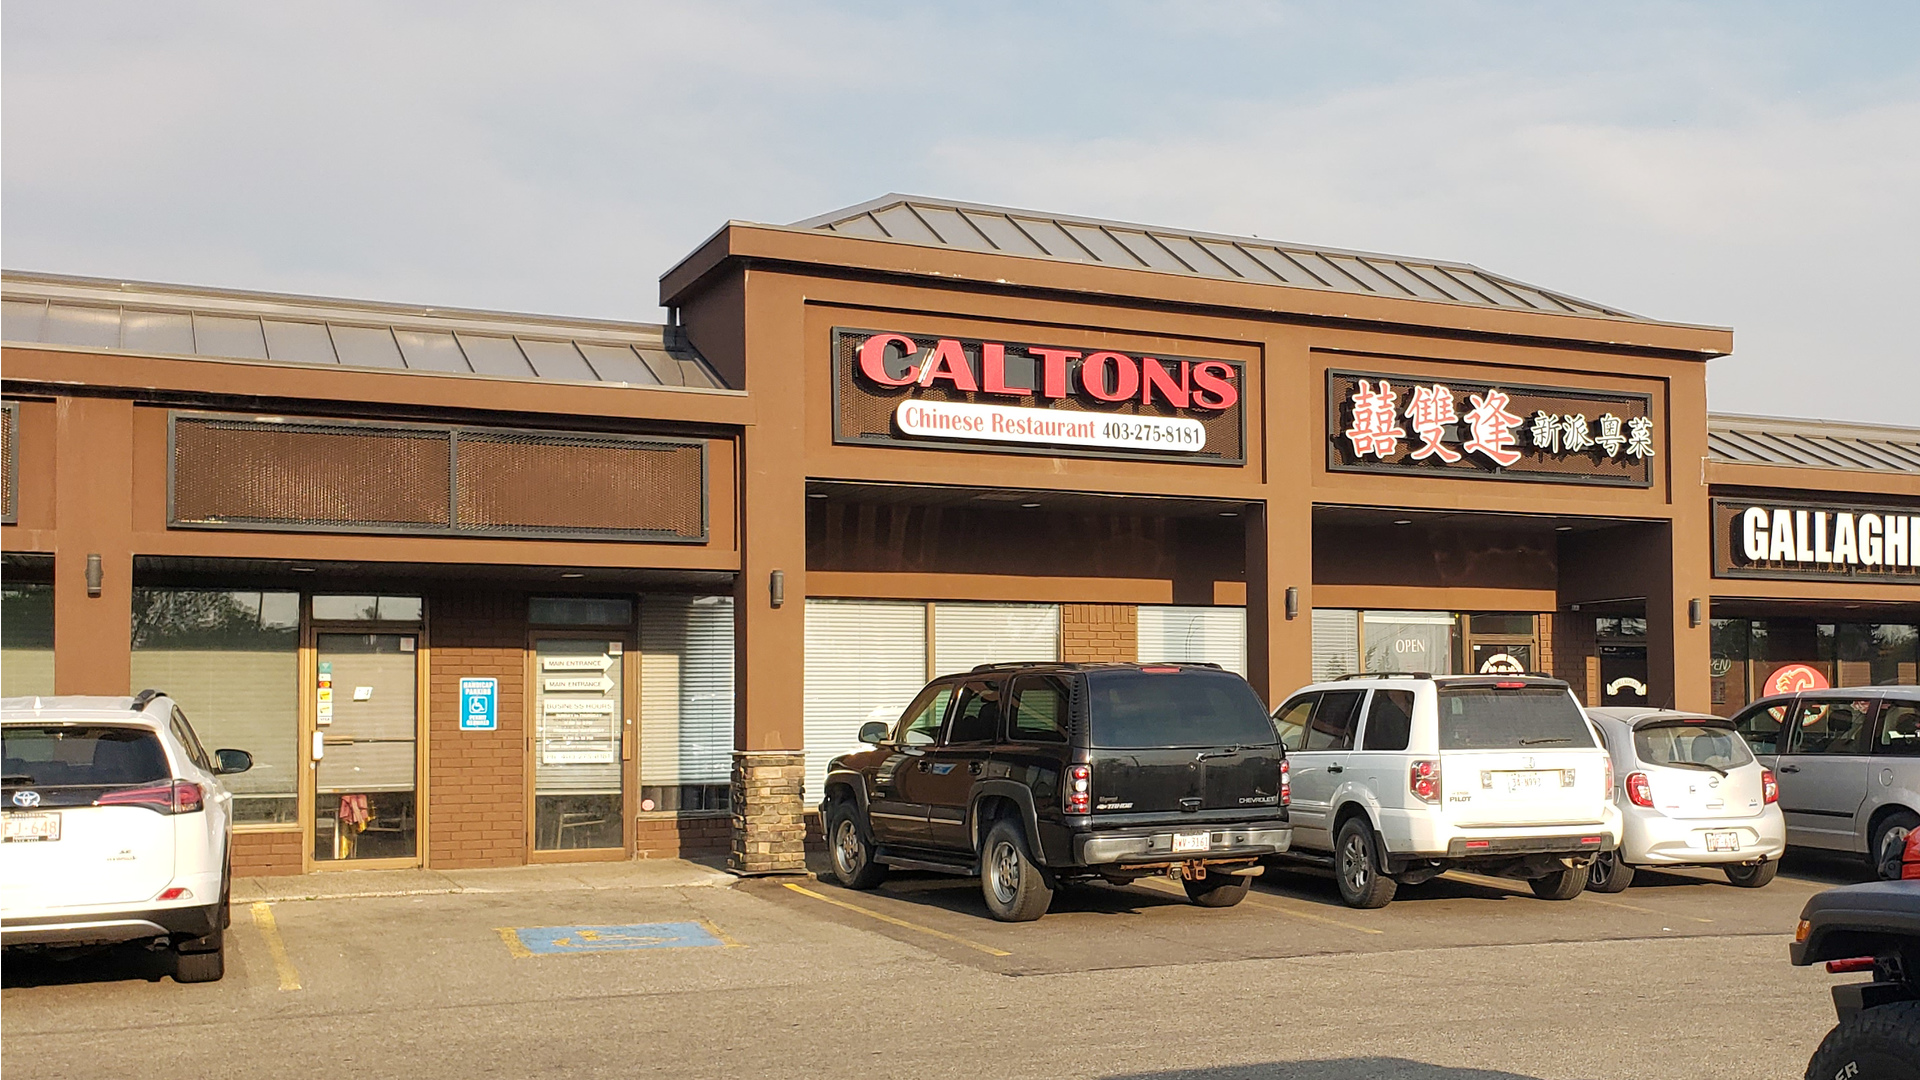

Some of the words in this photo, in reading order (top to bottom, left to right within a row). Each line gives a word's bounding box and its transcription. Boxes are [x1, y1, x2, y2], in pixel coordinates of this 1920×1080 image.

[860, 333, 1239, 410] CALTONS
[905, 406, 984, 432] Chinese
[991, 412, 1096, 439] Restaurant
[1102, 422, 1200, 445] 403-275-8181
[1395, 639, 1425, 653] OPEN
[1238, 796, 1276, 804] CHEVROLET
